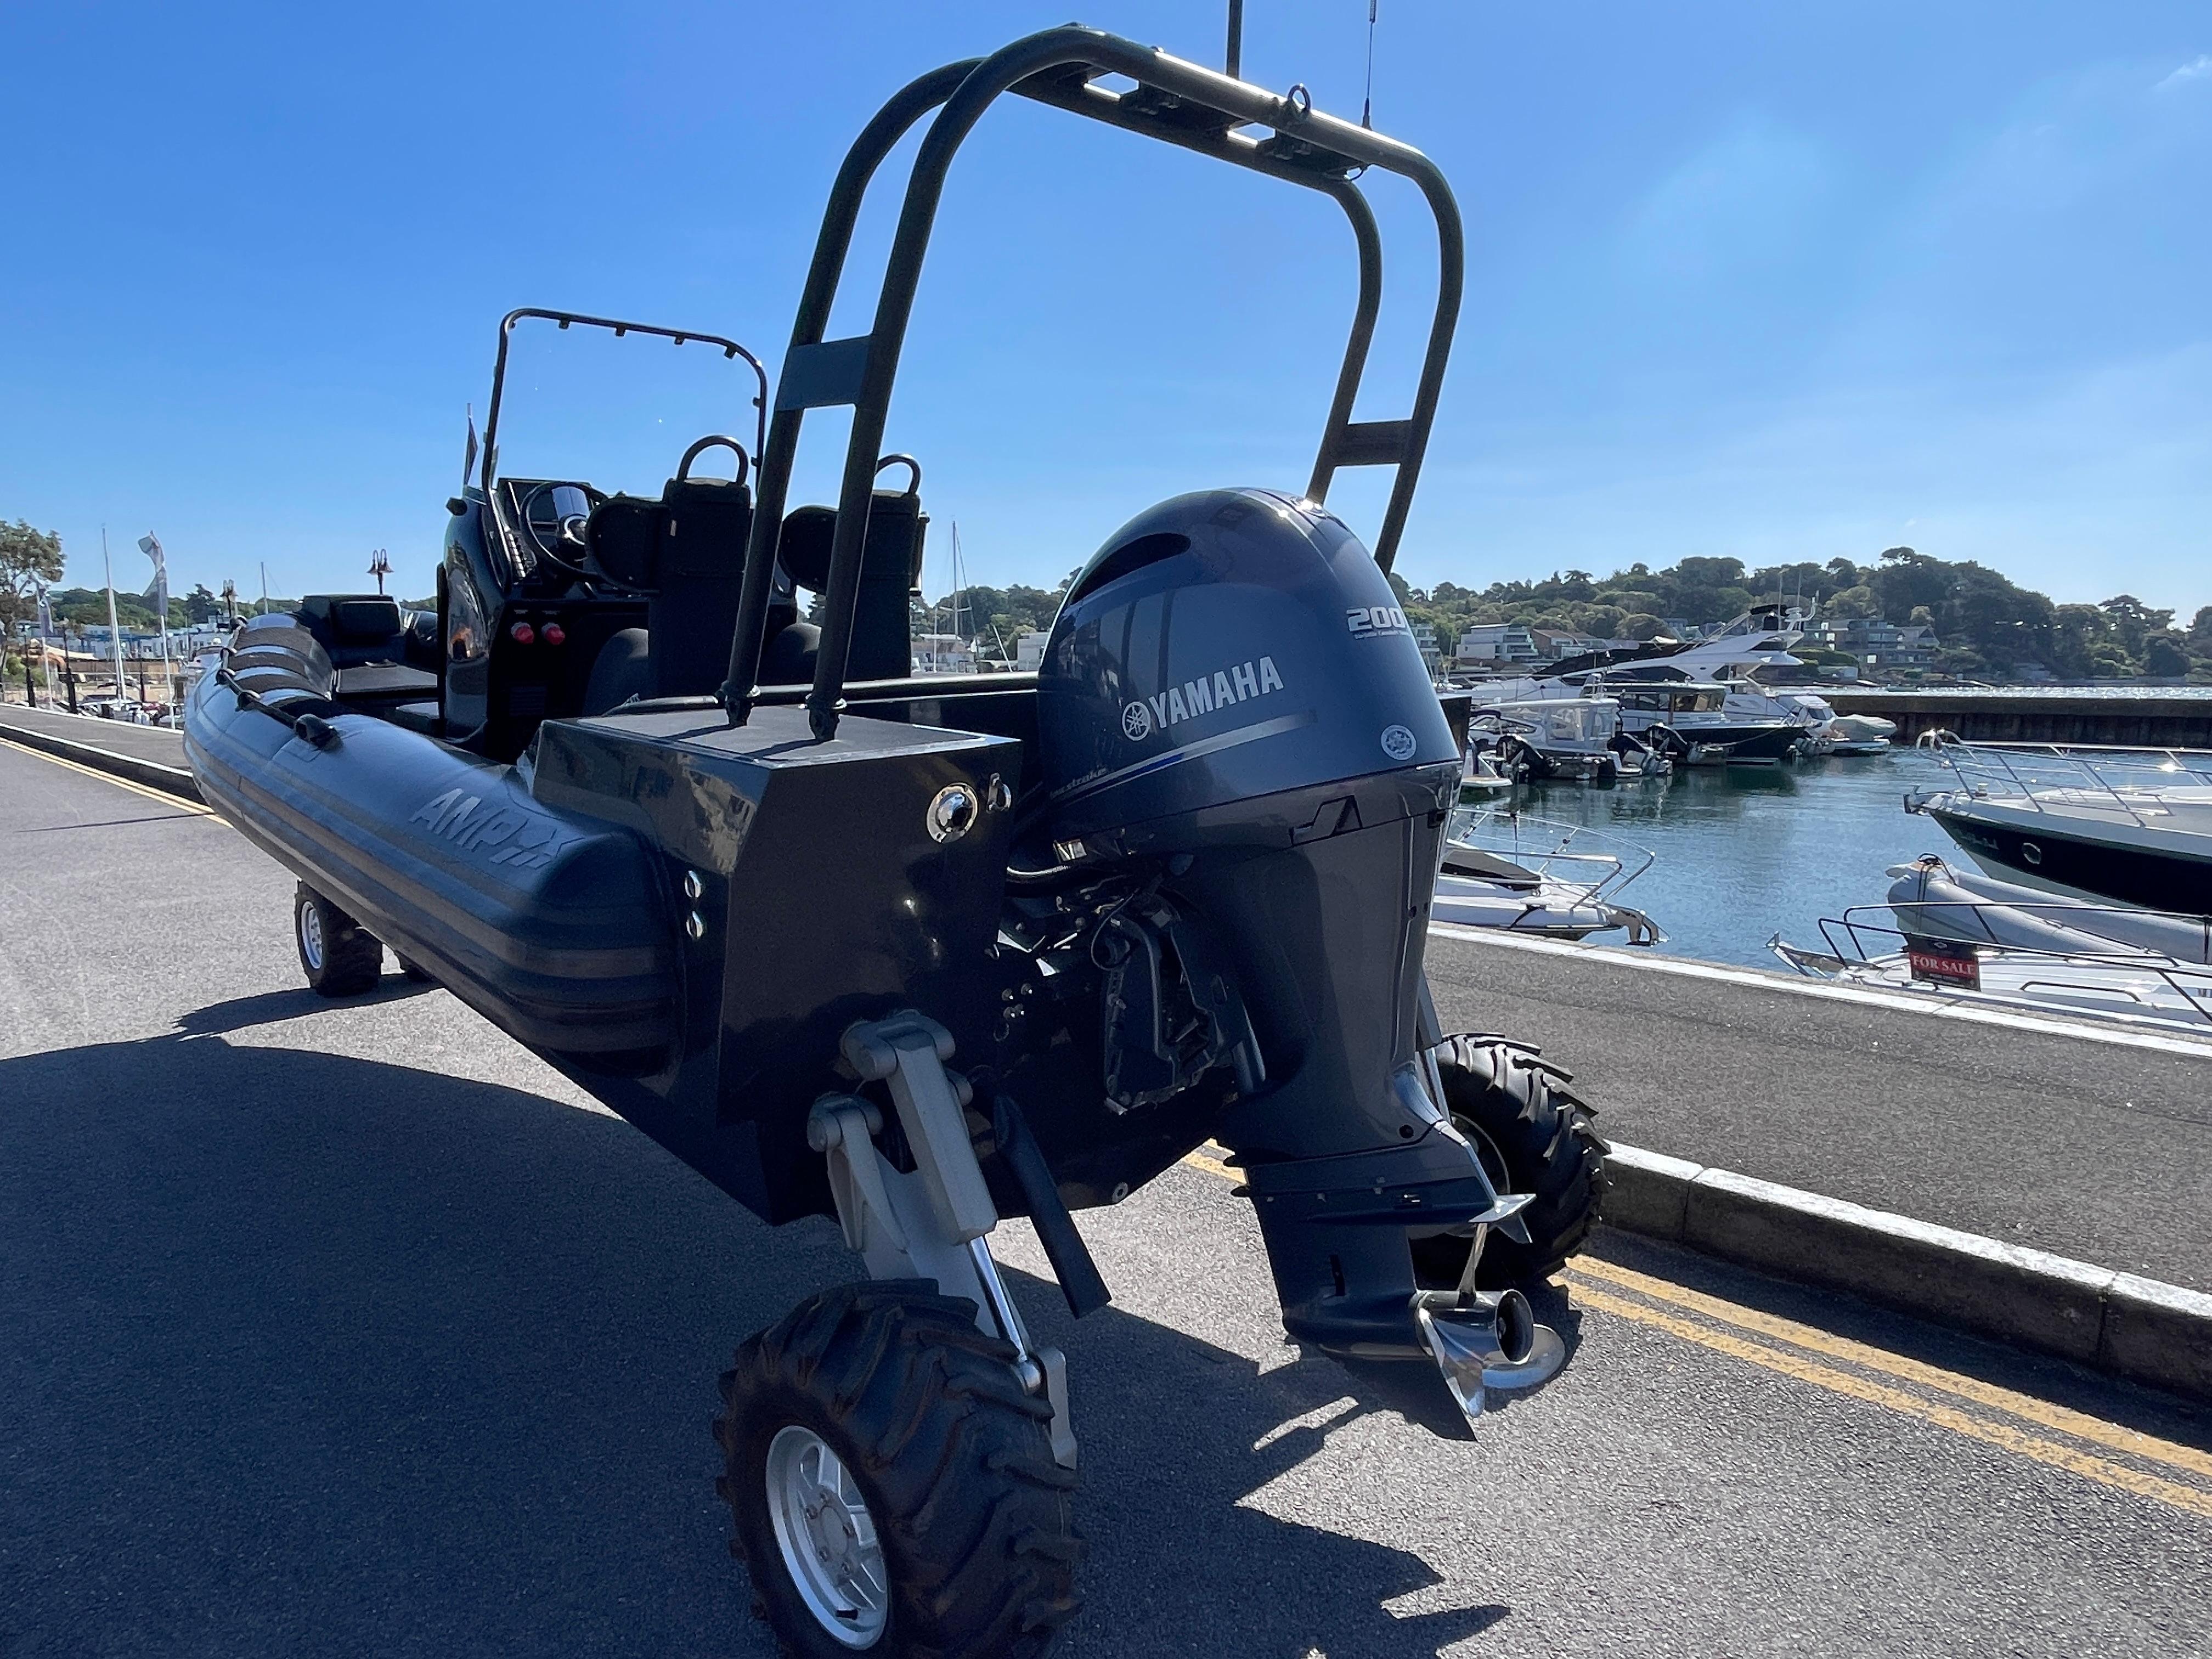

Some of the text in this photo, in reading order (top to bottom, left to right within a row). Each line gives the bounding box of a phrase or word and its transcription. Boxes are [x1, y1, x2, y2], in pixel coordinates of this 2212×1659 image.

[1346, 607, 1406, 631] 200
[1149, 656, 1284, 729] YAMAHA
[1913, 956, 1975, 974] FOR SALE
